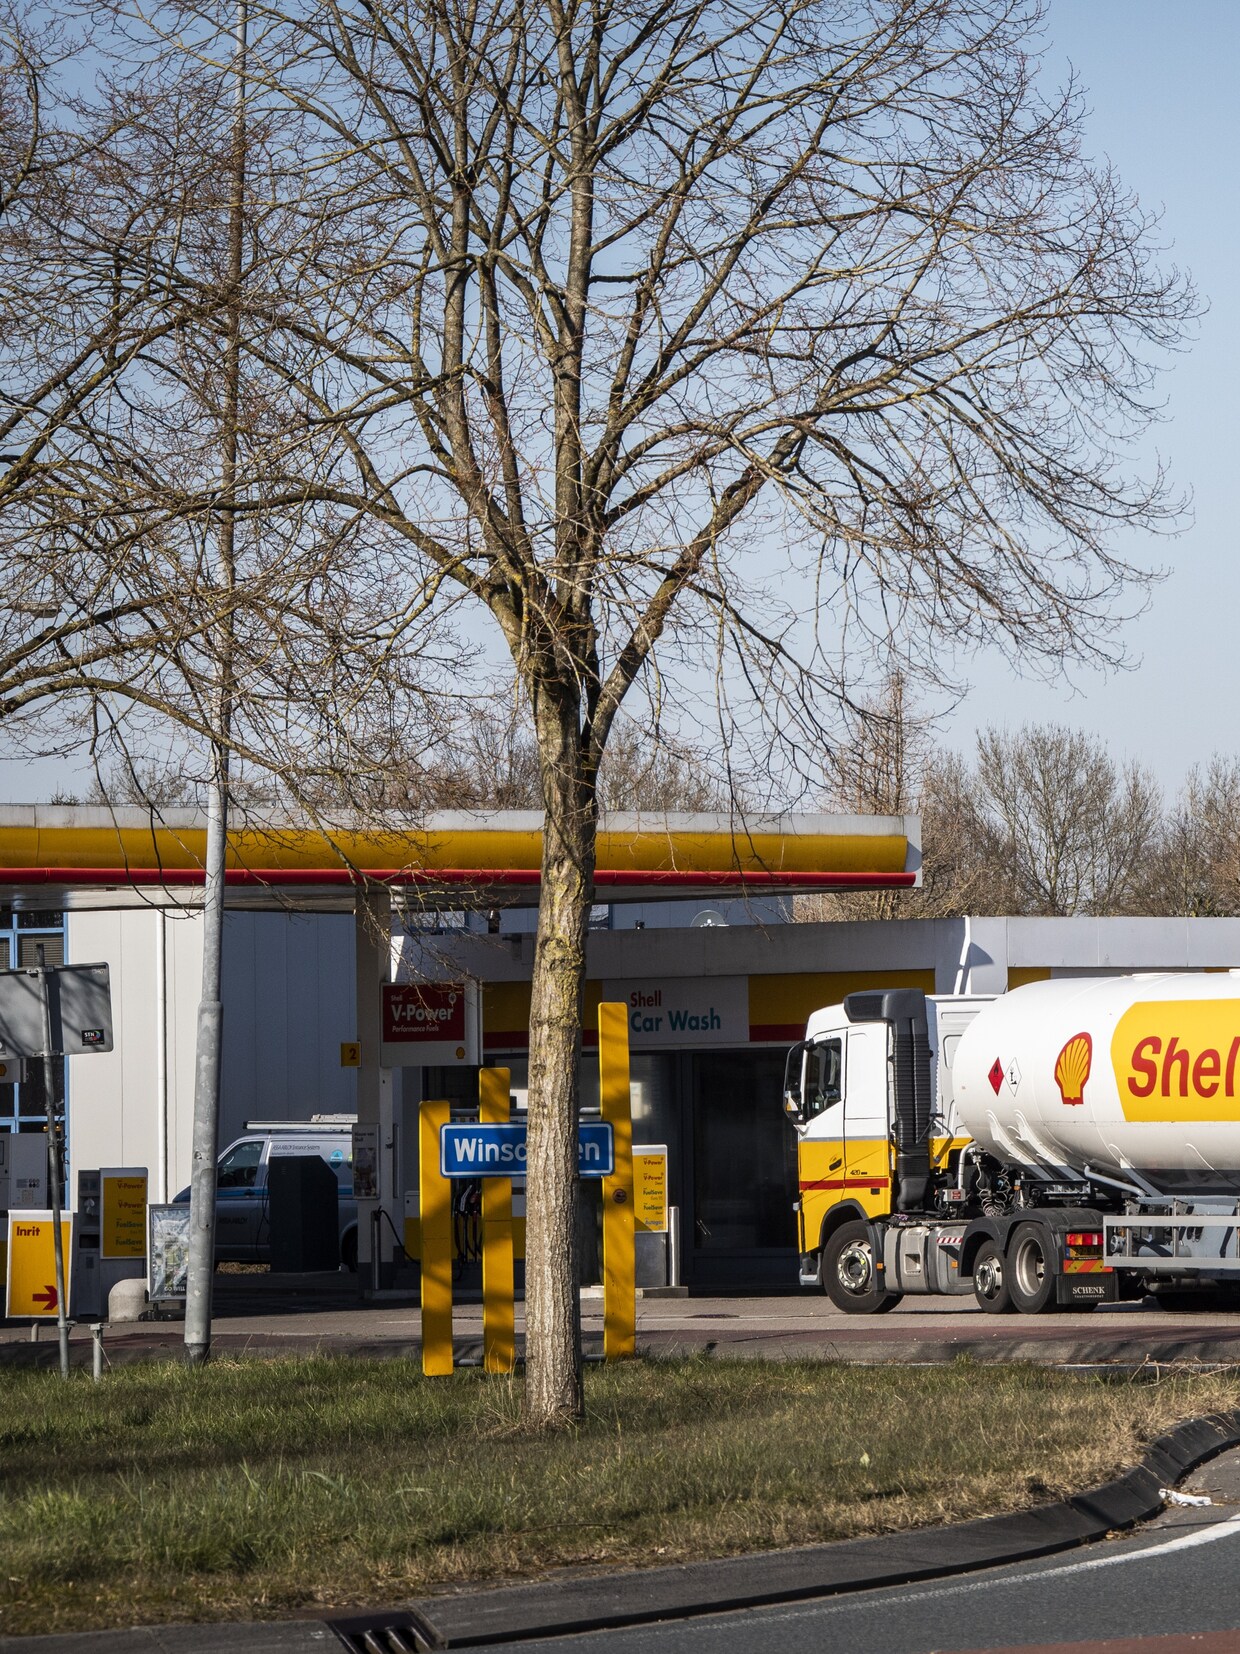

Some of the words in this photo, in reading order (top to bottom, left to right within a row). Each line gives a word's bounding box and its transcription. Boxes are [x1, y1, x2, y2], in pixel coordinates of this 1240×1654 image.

[630, 989, 662, 1008] Shell
[391, 1003, 454, 1021] V-Power
[630, 1011, 663, 1032] Car
[667, 1007, 721, 1032] Wash
[392, 1025, 426, 1033] Performance
[426, 1024, 440, 1032] Fuels
[349, 1048, 357, 1060] 2
[16, 1225, 40, 1236] Inrit
[1072, 1286, 1105, 1294] SCHENK
